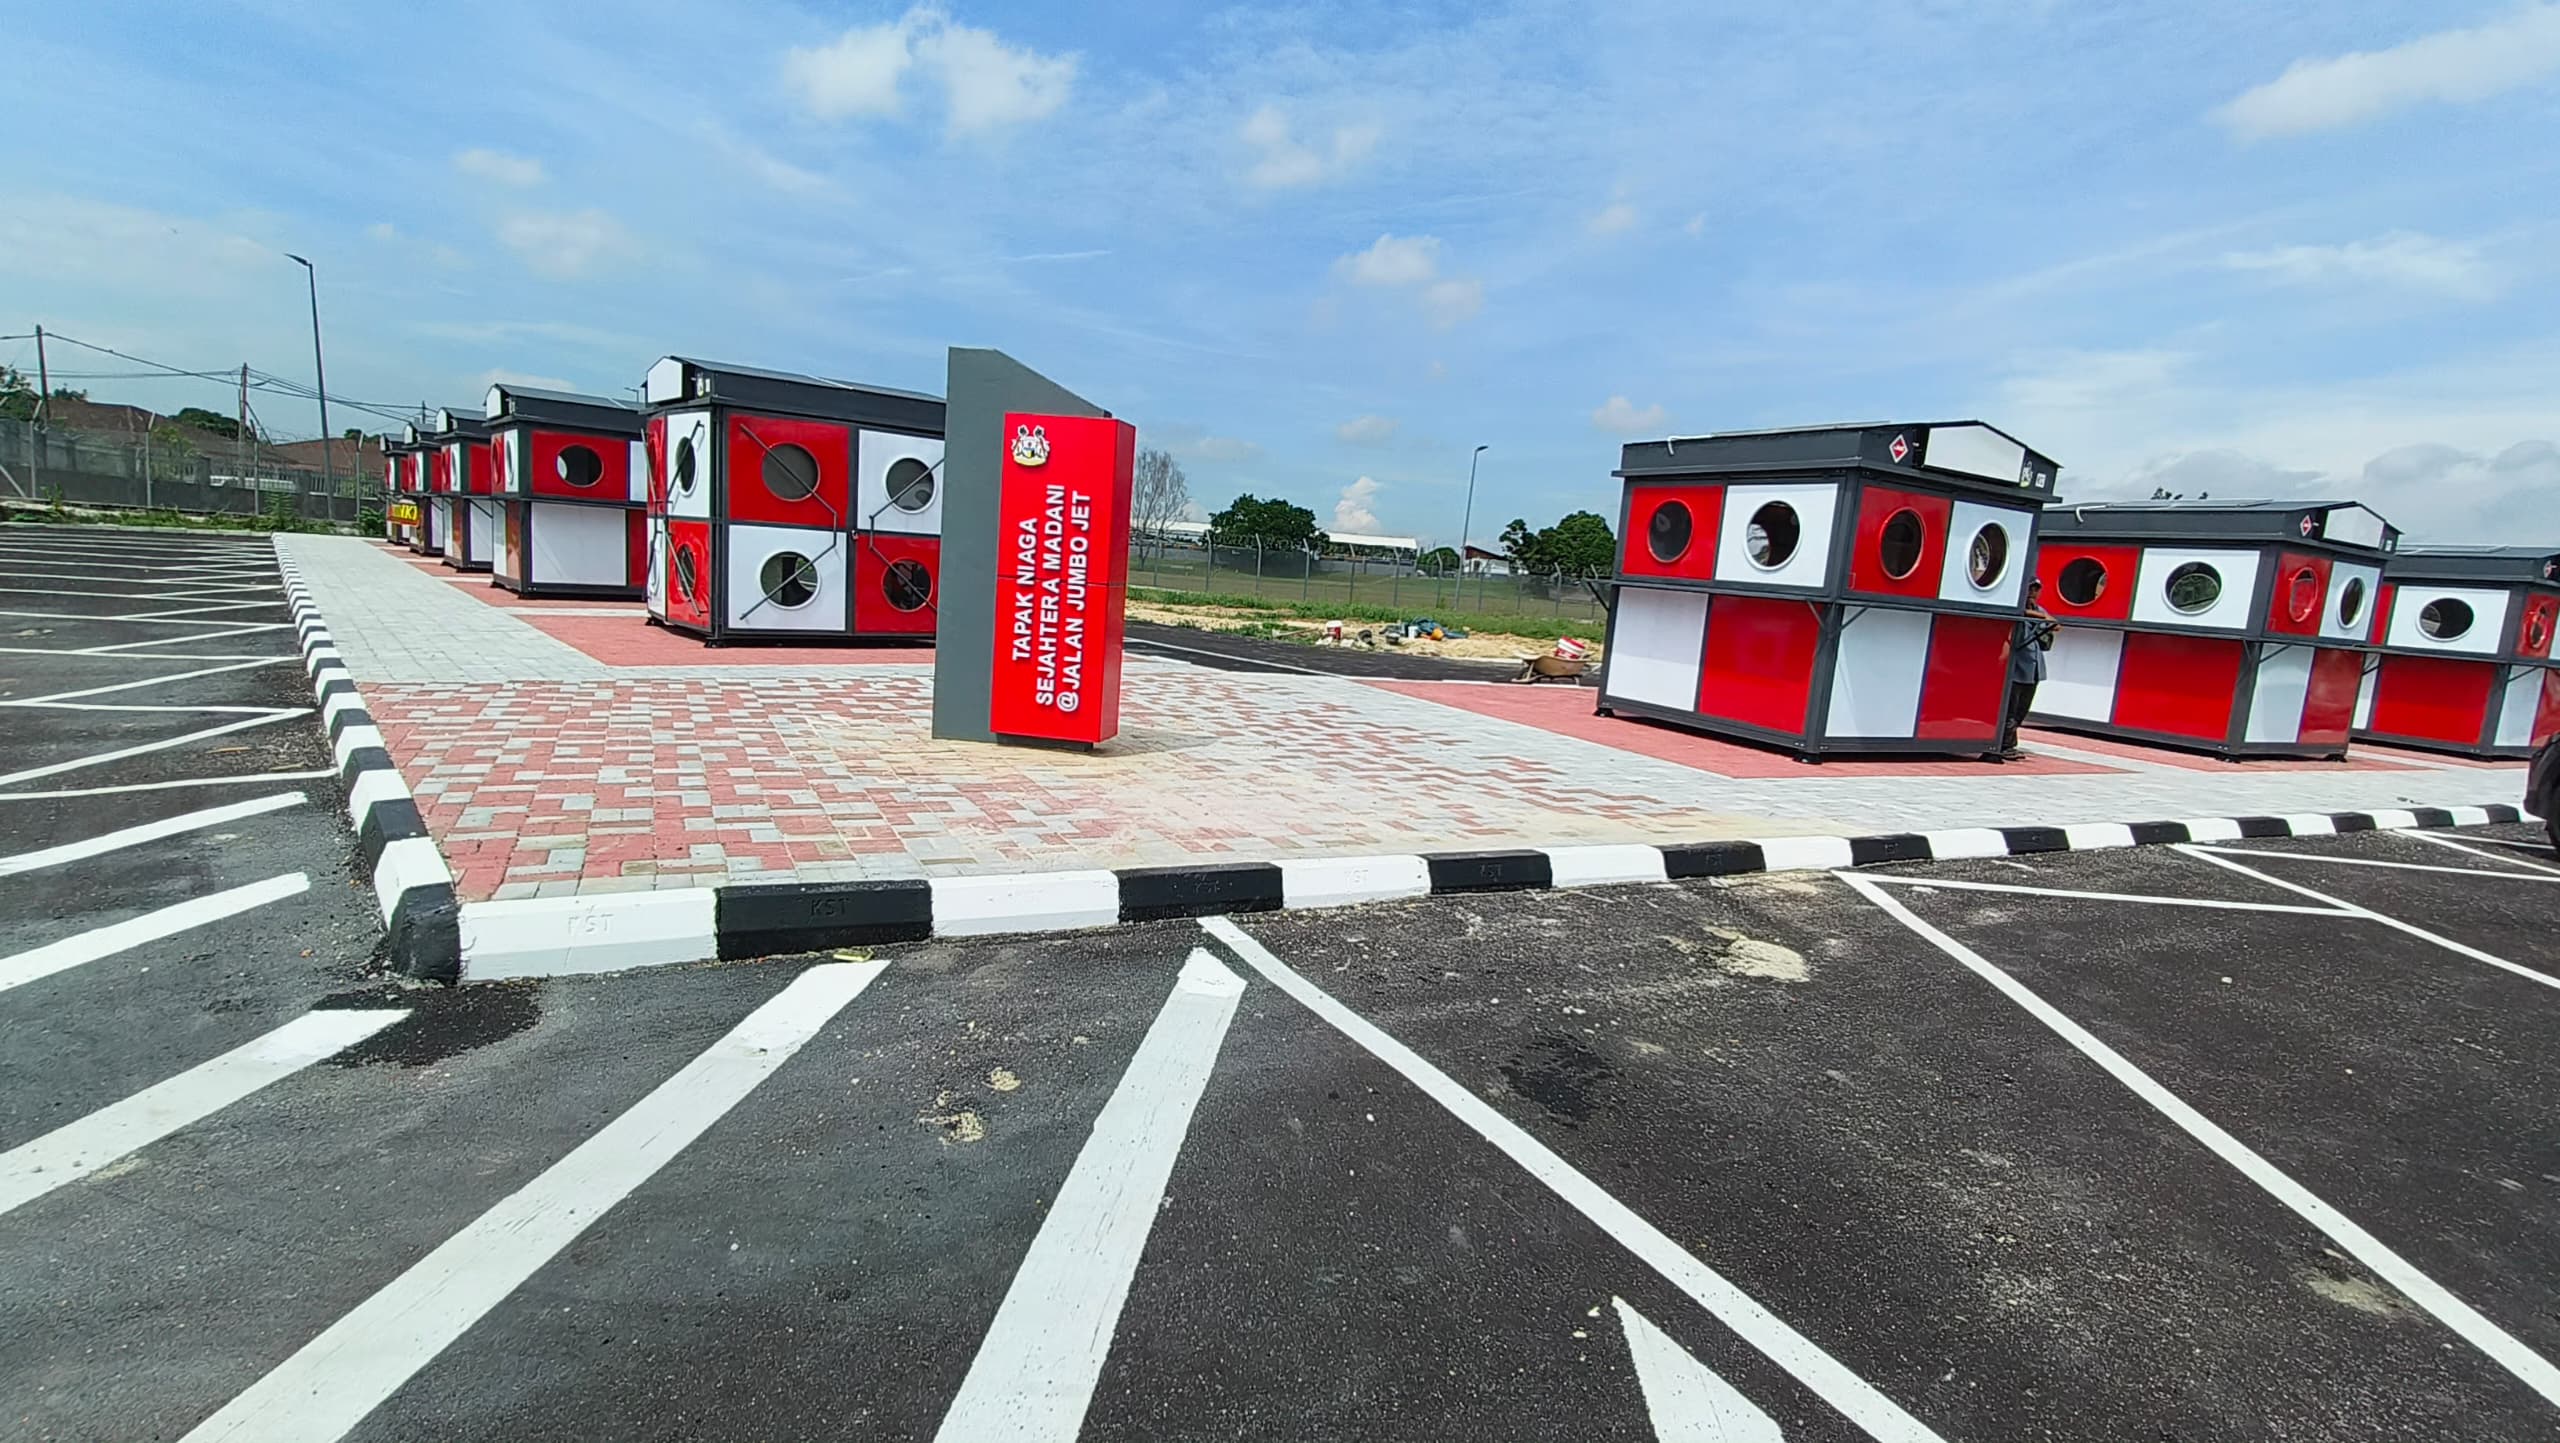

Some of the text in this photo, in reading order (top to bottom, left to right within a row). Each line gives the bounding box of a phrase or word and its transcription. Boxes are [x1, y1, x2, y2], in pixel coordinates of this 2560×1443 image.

[1013, 518, 1038, 661] TAPAK NIAGA
[1035, 484, 1065, 706] SEJAHTERA MADANI
[1056, 490, 1090, 712] @JALAN JUMBO JET
